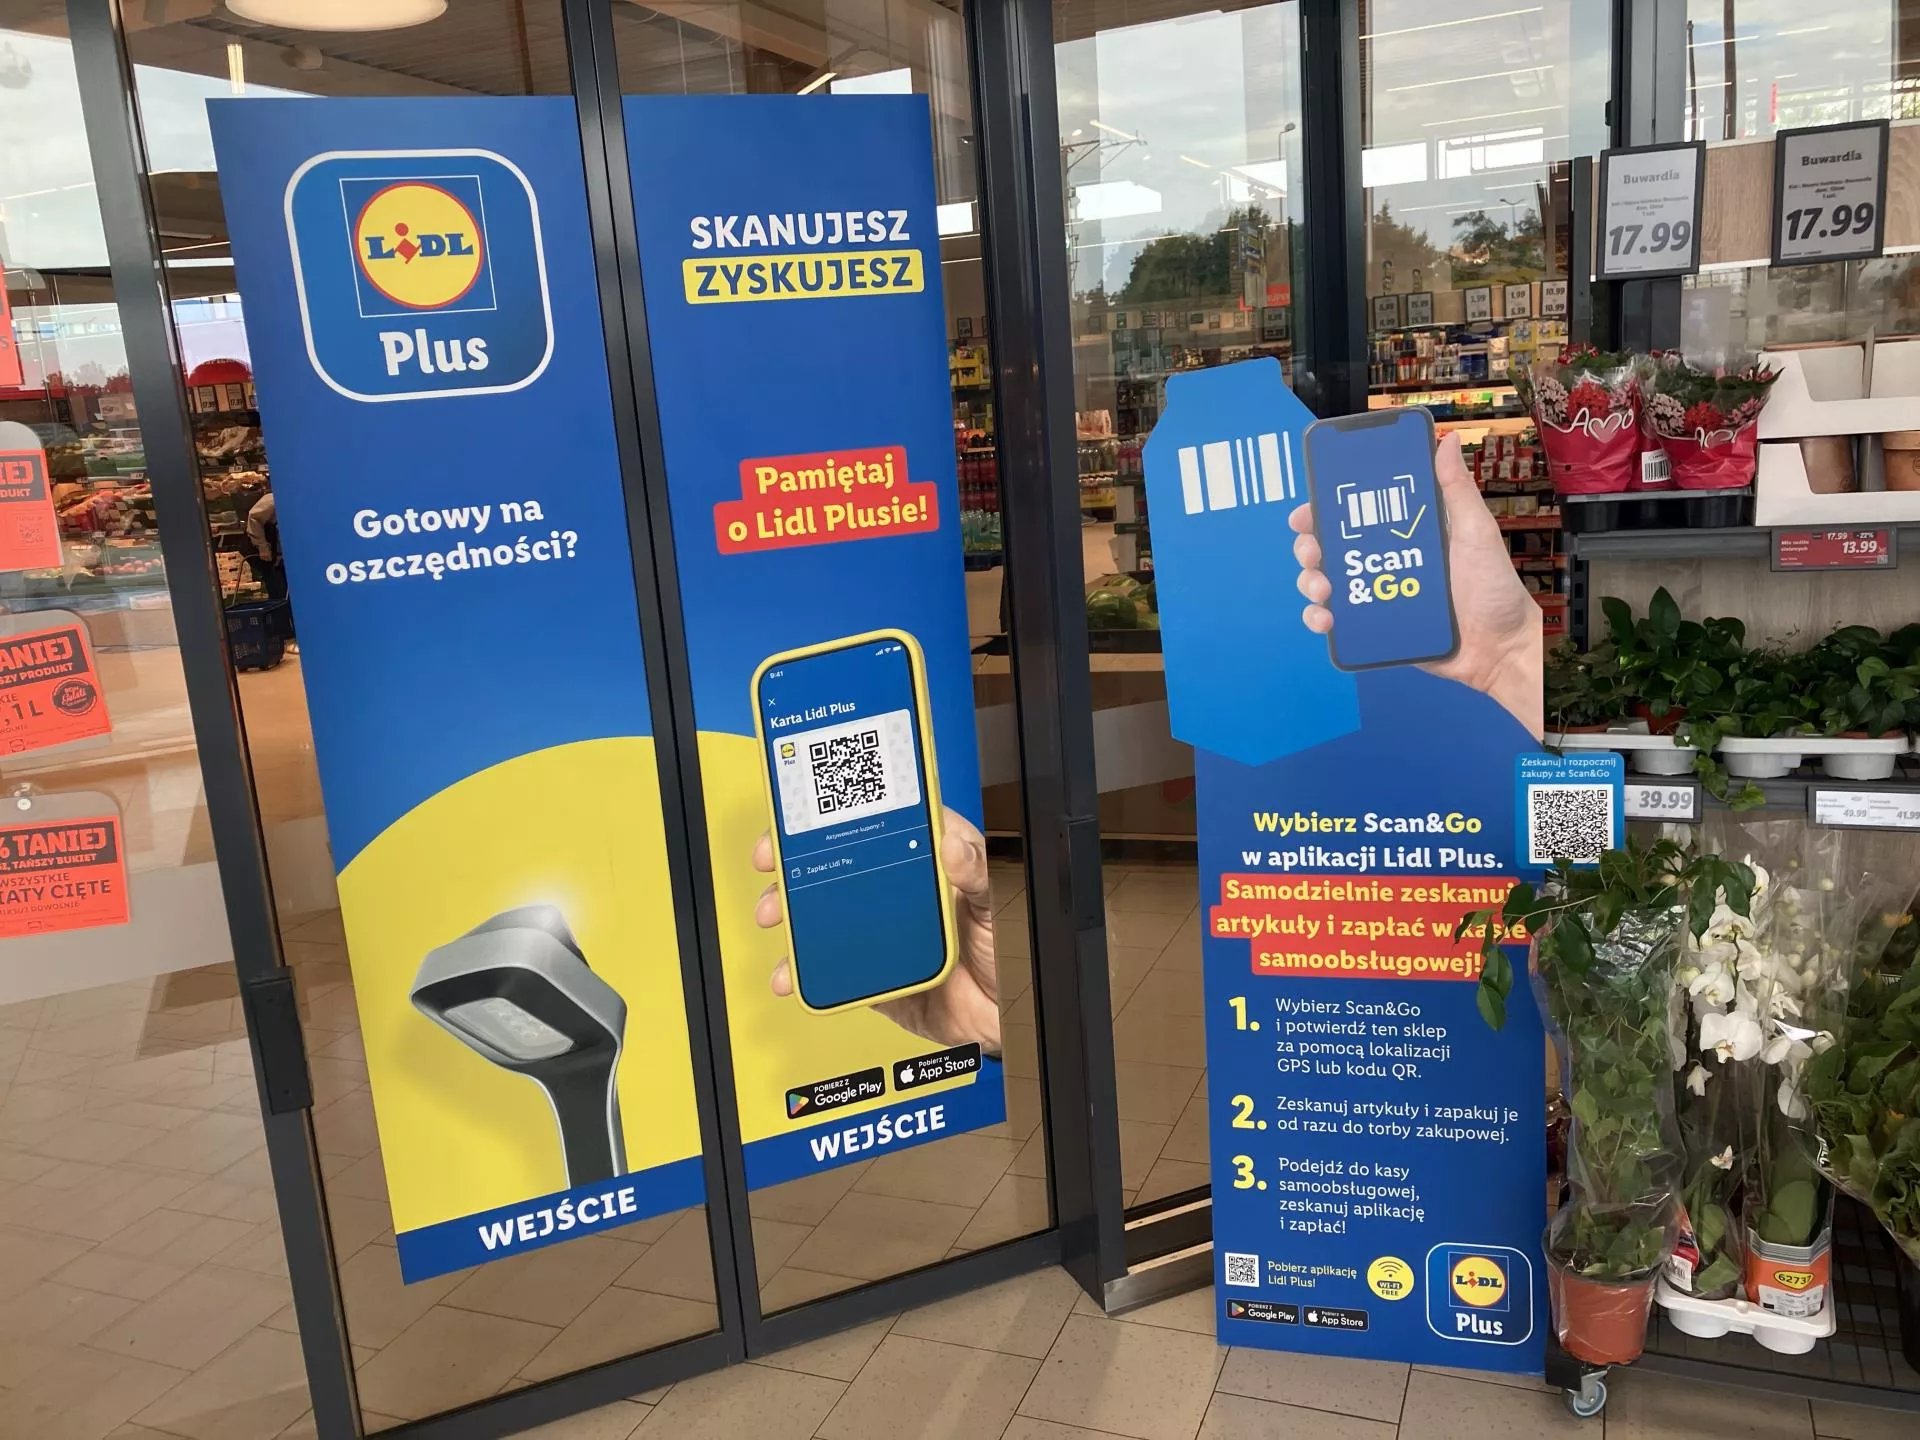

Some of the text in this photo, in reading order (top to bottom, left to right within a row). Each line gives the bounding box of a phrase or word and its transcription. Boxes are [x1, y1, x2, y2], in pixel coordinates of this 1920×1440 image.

[690, 210, 910, 250] SKANUJESZ
[1786, 202, 1874, 242] 17.99
[1609, 220, 1691, 256] 17.99
[695, 257, 913, 297] ZYSKUJESZ
[380, 328, 489, 377] Plus
[755, 453, 895, 494] Pamiętaj
[353, 500, 544, 539] Gotowy na
[728, 496, 928, 542] o Lidl Plusie!
[325, 530, 578, 585] oszczędności?
[1842, 540, 1878, 553] 13.99
[1344, 547, 1424, 576] Scan
[1348, 574, 1420, 605] &Go
[20, 662, 73, 680] PRODUKT
[770, 671, 784, 679] 9:41
[28, 700, 44, 717] L
[770, 702, 856, 728] Karta Lidl Plus
[1522, 758, 1561, 768] Zeskanuj
[1568, 758, 1616, 768] rozpocznij
[1522, 770, 1553, 779] zakupy
[1568, 770, 1610, 778] Scan&Go
[1639, 790, 1692, 810] 39.99
[1253, 811, 1482, 837] Wybierz Scan&Go
[13, 827, 107, 857] TANIEJ
[13, 858, 54, 869] TAŃSZY
[56, 853, 97, 864] BUKIET
[806, 864, 828, 874] Zapłać
[829, 860, 841, 869] Lidl
[1242, 845, 1504, 872] w aplikacji Lidl Plus.
[51, 879, 112, 900] CIĘTE
[1226, 879, 1394, 902] Samodzielnie
[1216, 913, 1321, 939] artykuły
[1327, 914, 1334, 935] i
[1341, 916, 1425, 941] zapłać
[1432, 923, 1452, 938] w
[1260, 949, 1481, 978] samoobsługowej!
[1229, 996, 1260, 1032] 1.
[1275, 998, 1421, 1017] Wybierz Scan&Go
[1276, 1019, 1447, 1041] i potwierdź ten sklep
[918, 1056, 942, 1068] Pobierz
[1276, 1041, 1450, 1062] za pomocą lokalizacji
[919, 1057, 976, 1081] App Store
[1277, 1058, 1422, 1080] GPS lub kodu QR.
[814, 1080, 842, 1094] POBIERZ
[814, 1081, 883, 1107] Google Play
[1231, 1094, 1267, 1131] 2.
[1277, 1096, 1519, 1124] Zeskanuj artykuły i zapakuj je
[810, 1104, 946, 1162] WEJŚCIE
[1277, 1117, 1510, 1145] od razu do torby zakupowej.
[1232, 1155, 1267, 1191] 3.
[1278, 1157, 1410, 1181] Podejdź do kasy
[1279, 1178, 1420, 1201] samoobsługowej,
[478, 1187, 637, 1250] WEJŚCIE
[1279, 1199, 1425, 1223] zeskanuj aplikację
[1280, 1217, 1346, 1235] i zapłać!
[1268, 1260, 1357, 1279] Pobierz aplikację
[1268, 1274, 1316, 1288] Lidl Plus!
[1379, 1281, 1401, 1290] WI-FI
[1381, 1288, 1399, 1297] FREE
[1248, 1308, 1295, 1322] Google Play
[1321, 1316, 1364, 1327] App Store
[1455, 1313, 1503, 1336] Plus
